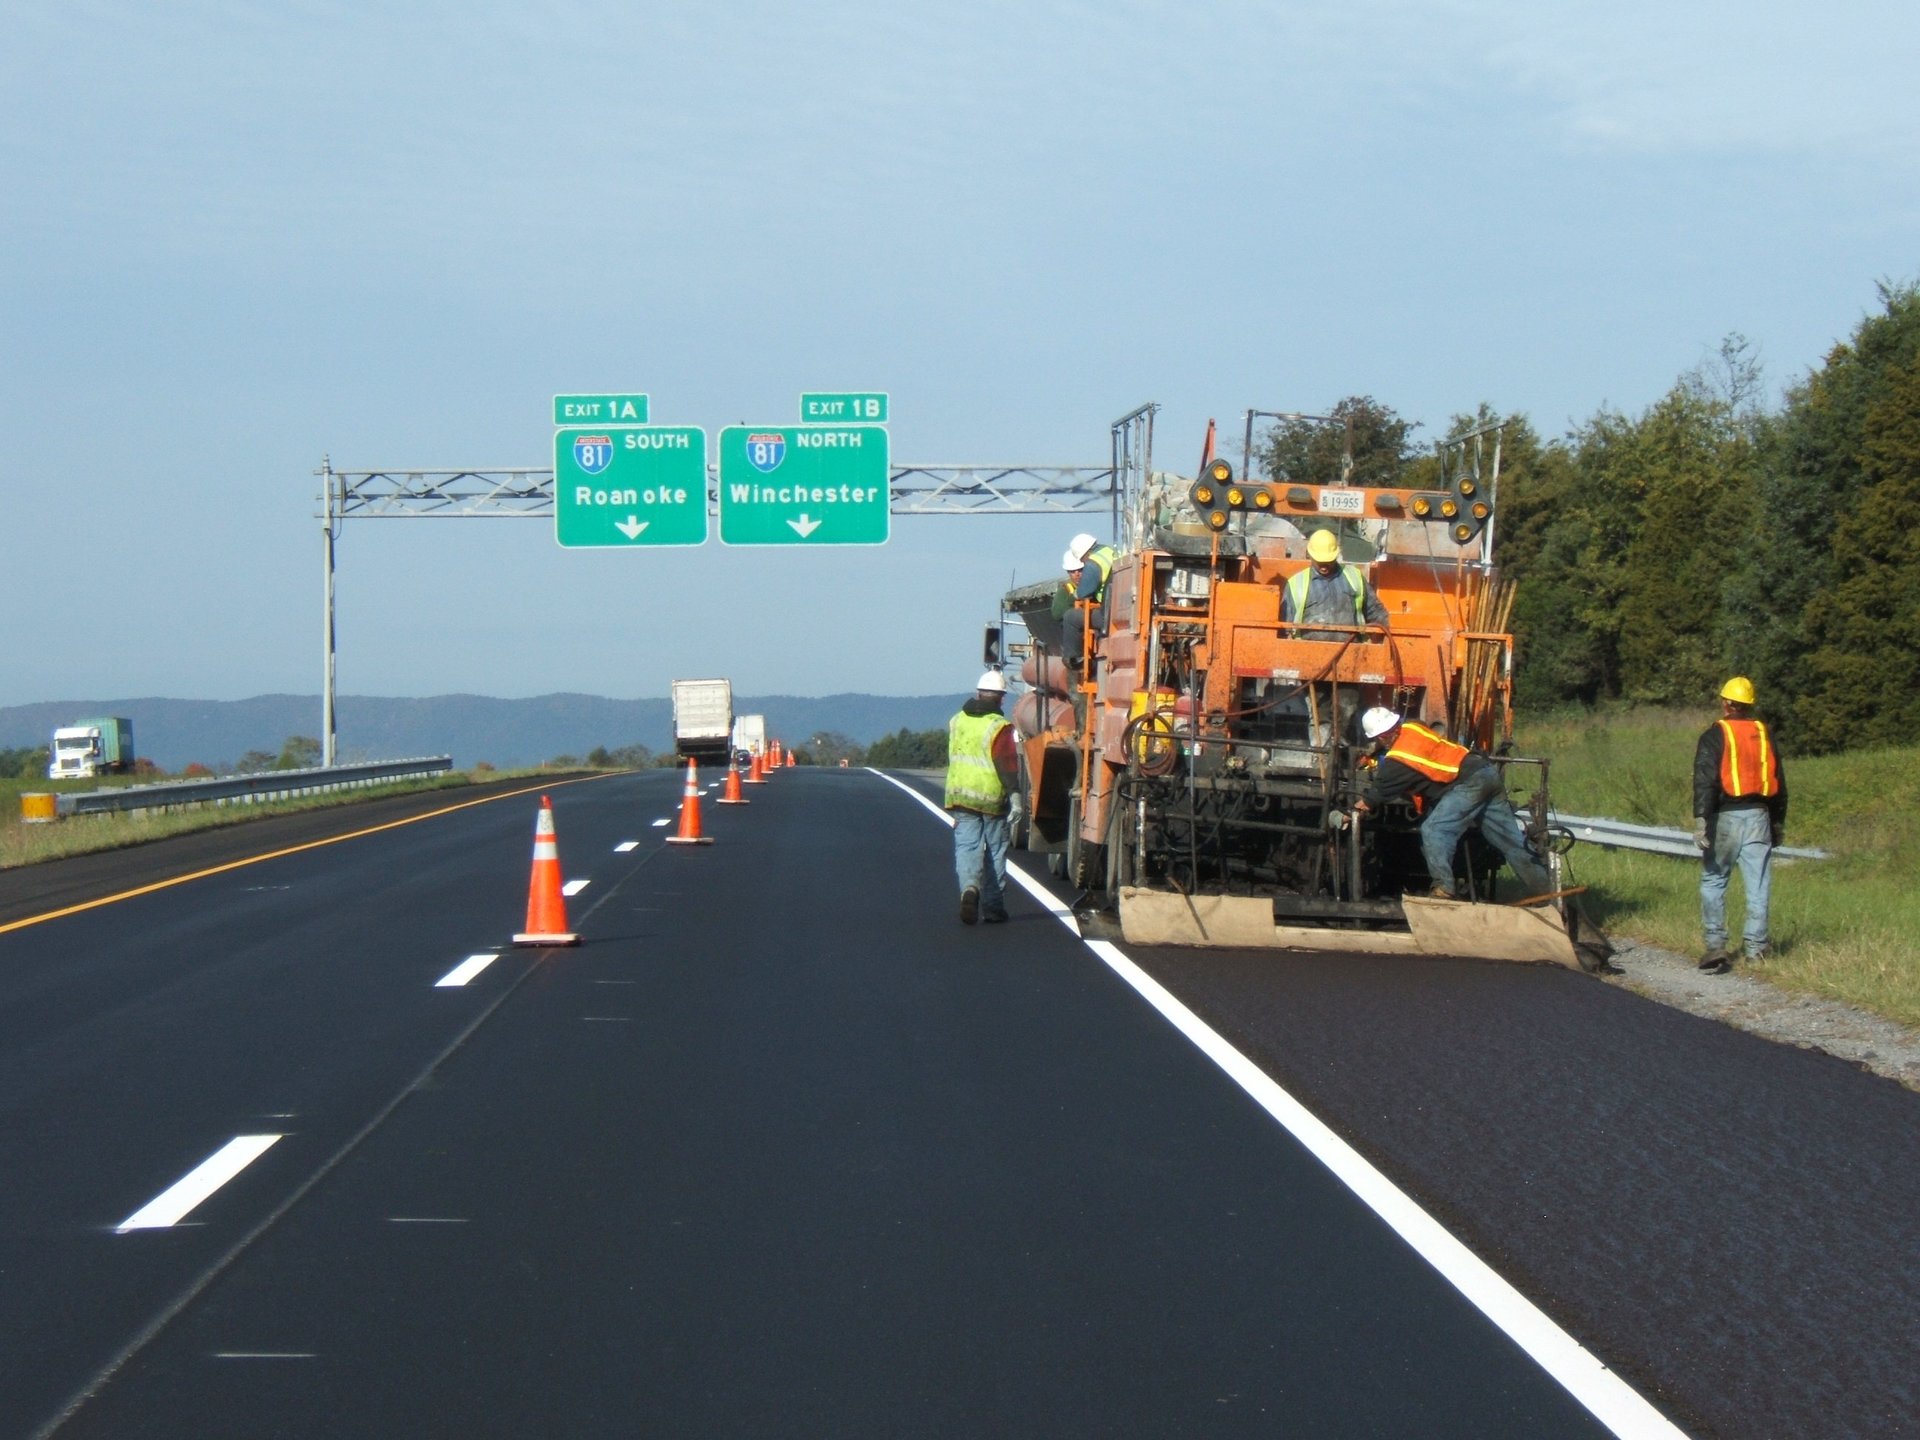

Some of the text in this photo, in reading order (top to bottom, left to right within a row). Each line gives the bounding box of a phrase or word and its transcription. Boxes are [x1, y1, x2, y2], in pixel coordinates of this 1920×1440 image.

[564, 401, 638, 418] EXIT 1A
[808, 399, 880, 417] EXIT 1B
[624, 434, 690, 449] SOUTH
[797, 432, 862, 447] NORTH
[582, 445, 604, 467] 81
[754, 443, 776, 465] 81
[575, 485, 688, 505] Roanoke
[730, 483, 878, 504] Winchester
[1332, 497, 1359, 508] 19-955
